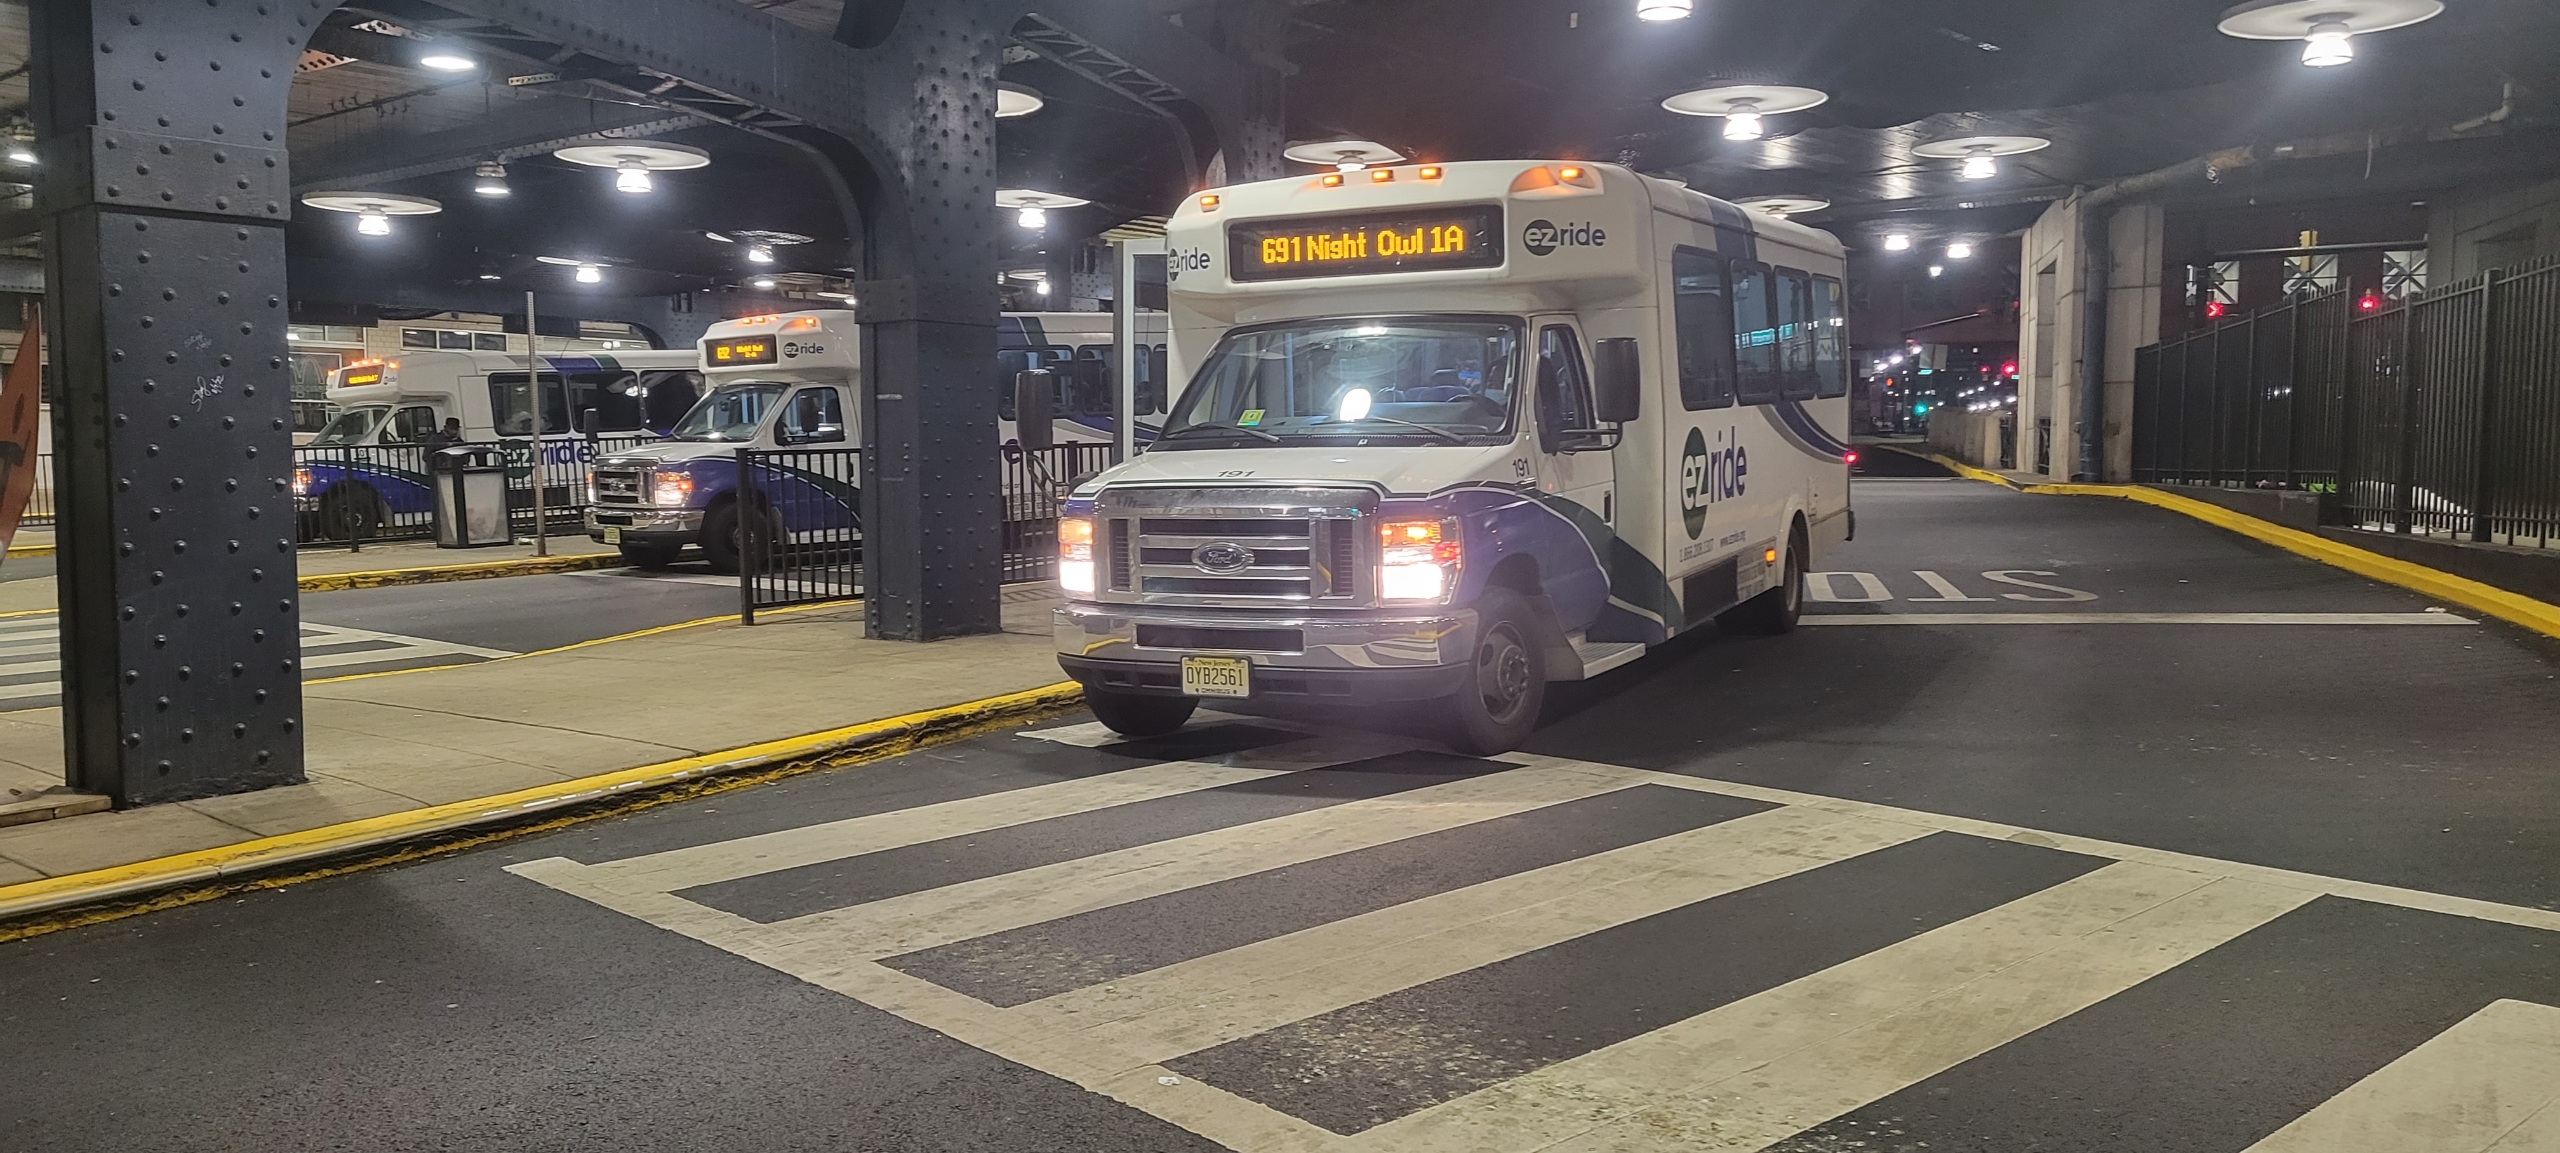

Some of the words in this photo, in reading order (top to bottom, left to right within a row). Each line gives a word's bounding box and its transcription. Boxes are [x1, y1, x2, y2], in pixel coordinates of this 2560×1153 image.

[1262, 235, 1301, 265] 691
[1307, 232, 1368, 262] Night
[1377, 228, 1424, 258] Owl
[1430, 224, 1465, 254] 1A
[1217, 470, 1256, 478] 191
[1512, 457, 1530, 478] 191
[1206, 550, 1236, 564] Ford
[1805, 569, 2099, 602] STO
